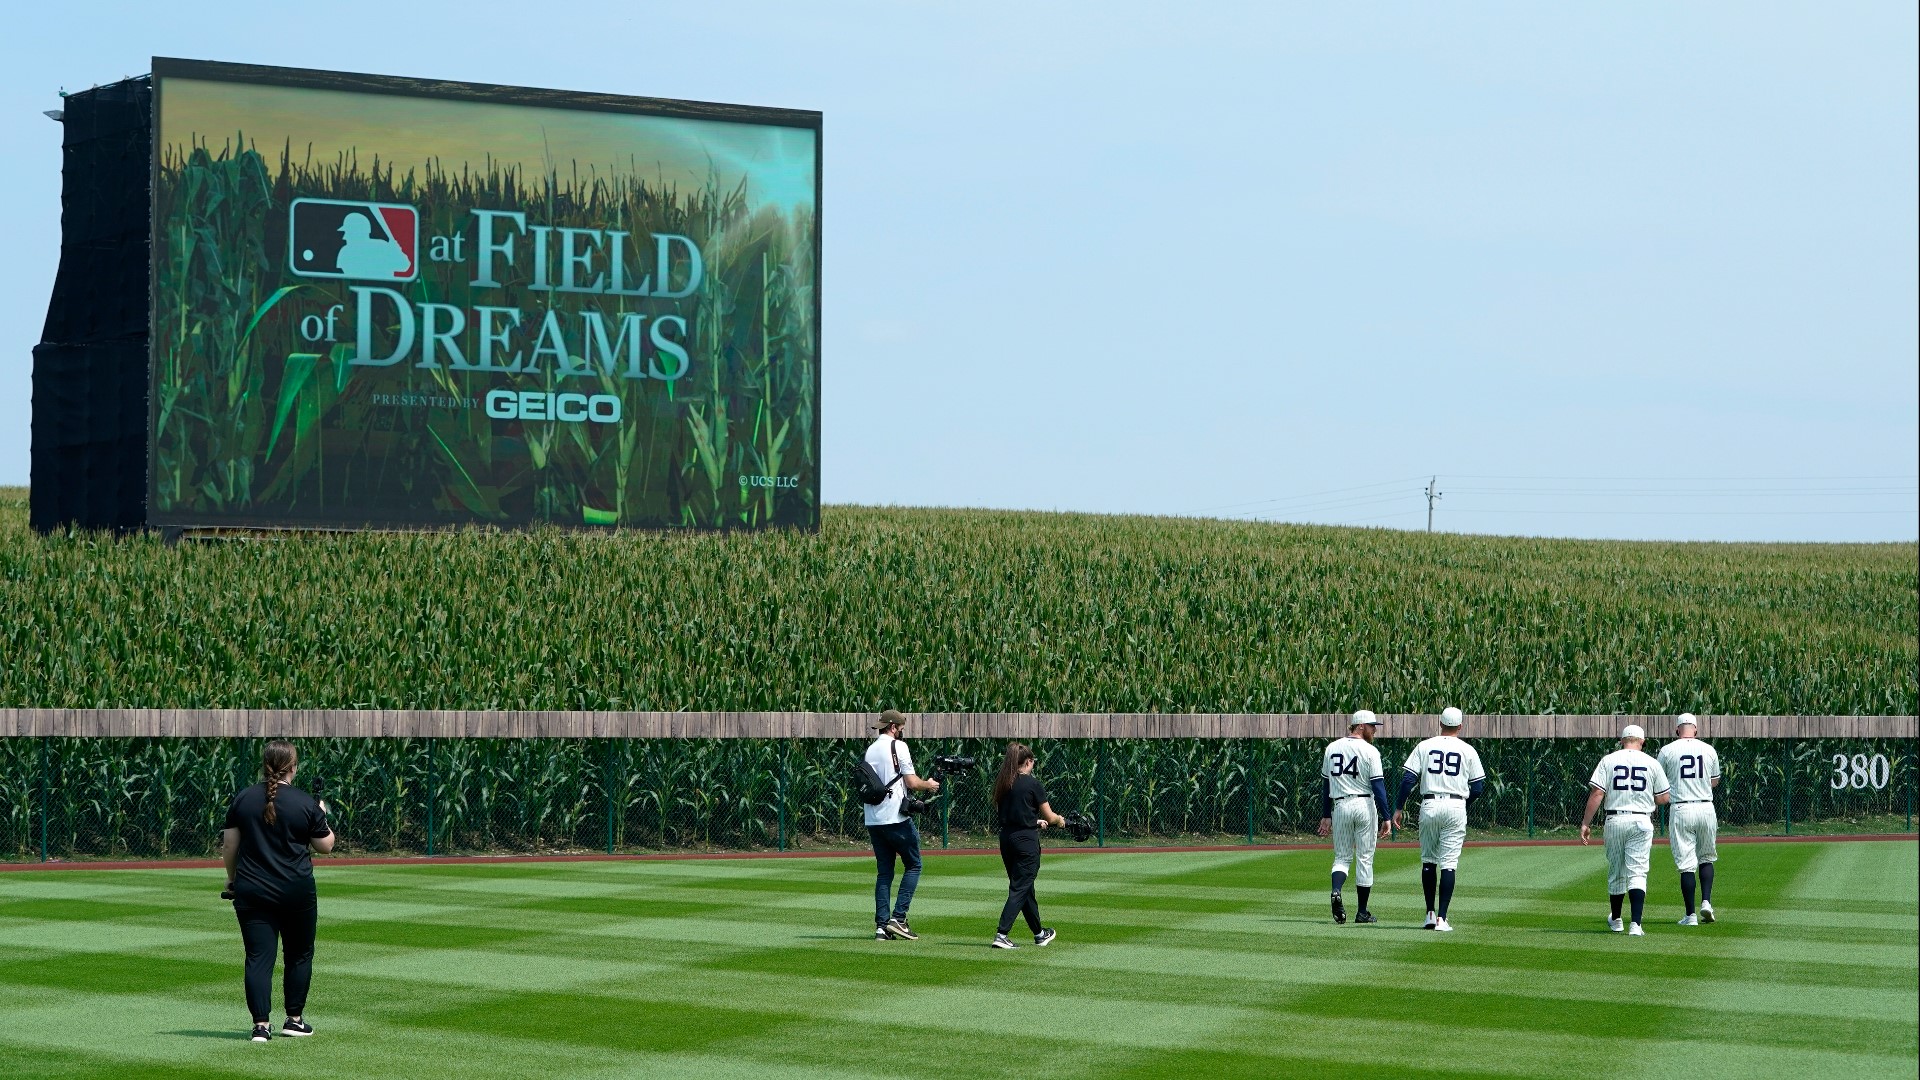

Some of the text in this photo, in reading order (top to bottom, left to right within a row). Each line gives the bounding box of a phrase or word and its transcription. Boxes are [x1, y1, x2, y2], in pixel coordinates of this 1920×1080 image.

[430, 208, 701, 299] at FIELD
[300, 304, 344, 341] of
[348, 285, 690, 380] DREAMS
[372, 389, 621, 423] PRESENTED BY GEICO
[750, 475, 775, 487] UCS
[776, 476, 799, 488] LLC
[1330, 753, 1359, 779] 34
[1427, 749, 1462, 777] 39
[1679, 754, 1704, 779] 21
[1831, 753, 1890, 790] 380
[1613, 765, 1648, 792] 25
